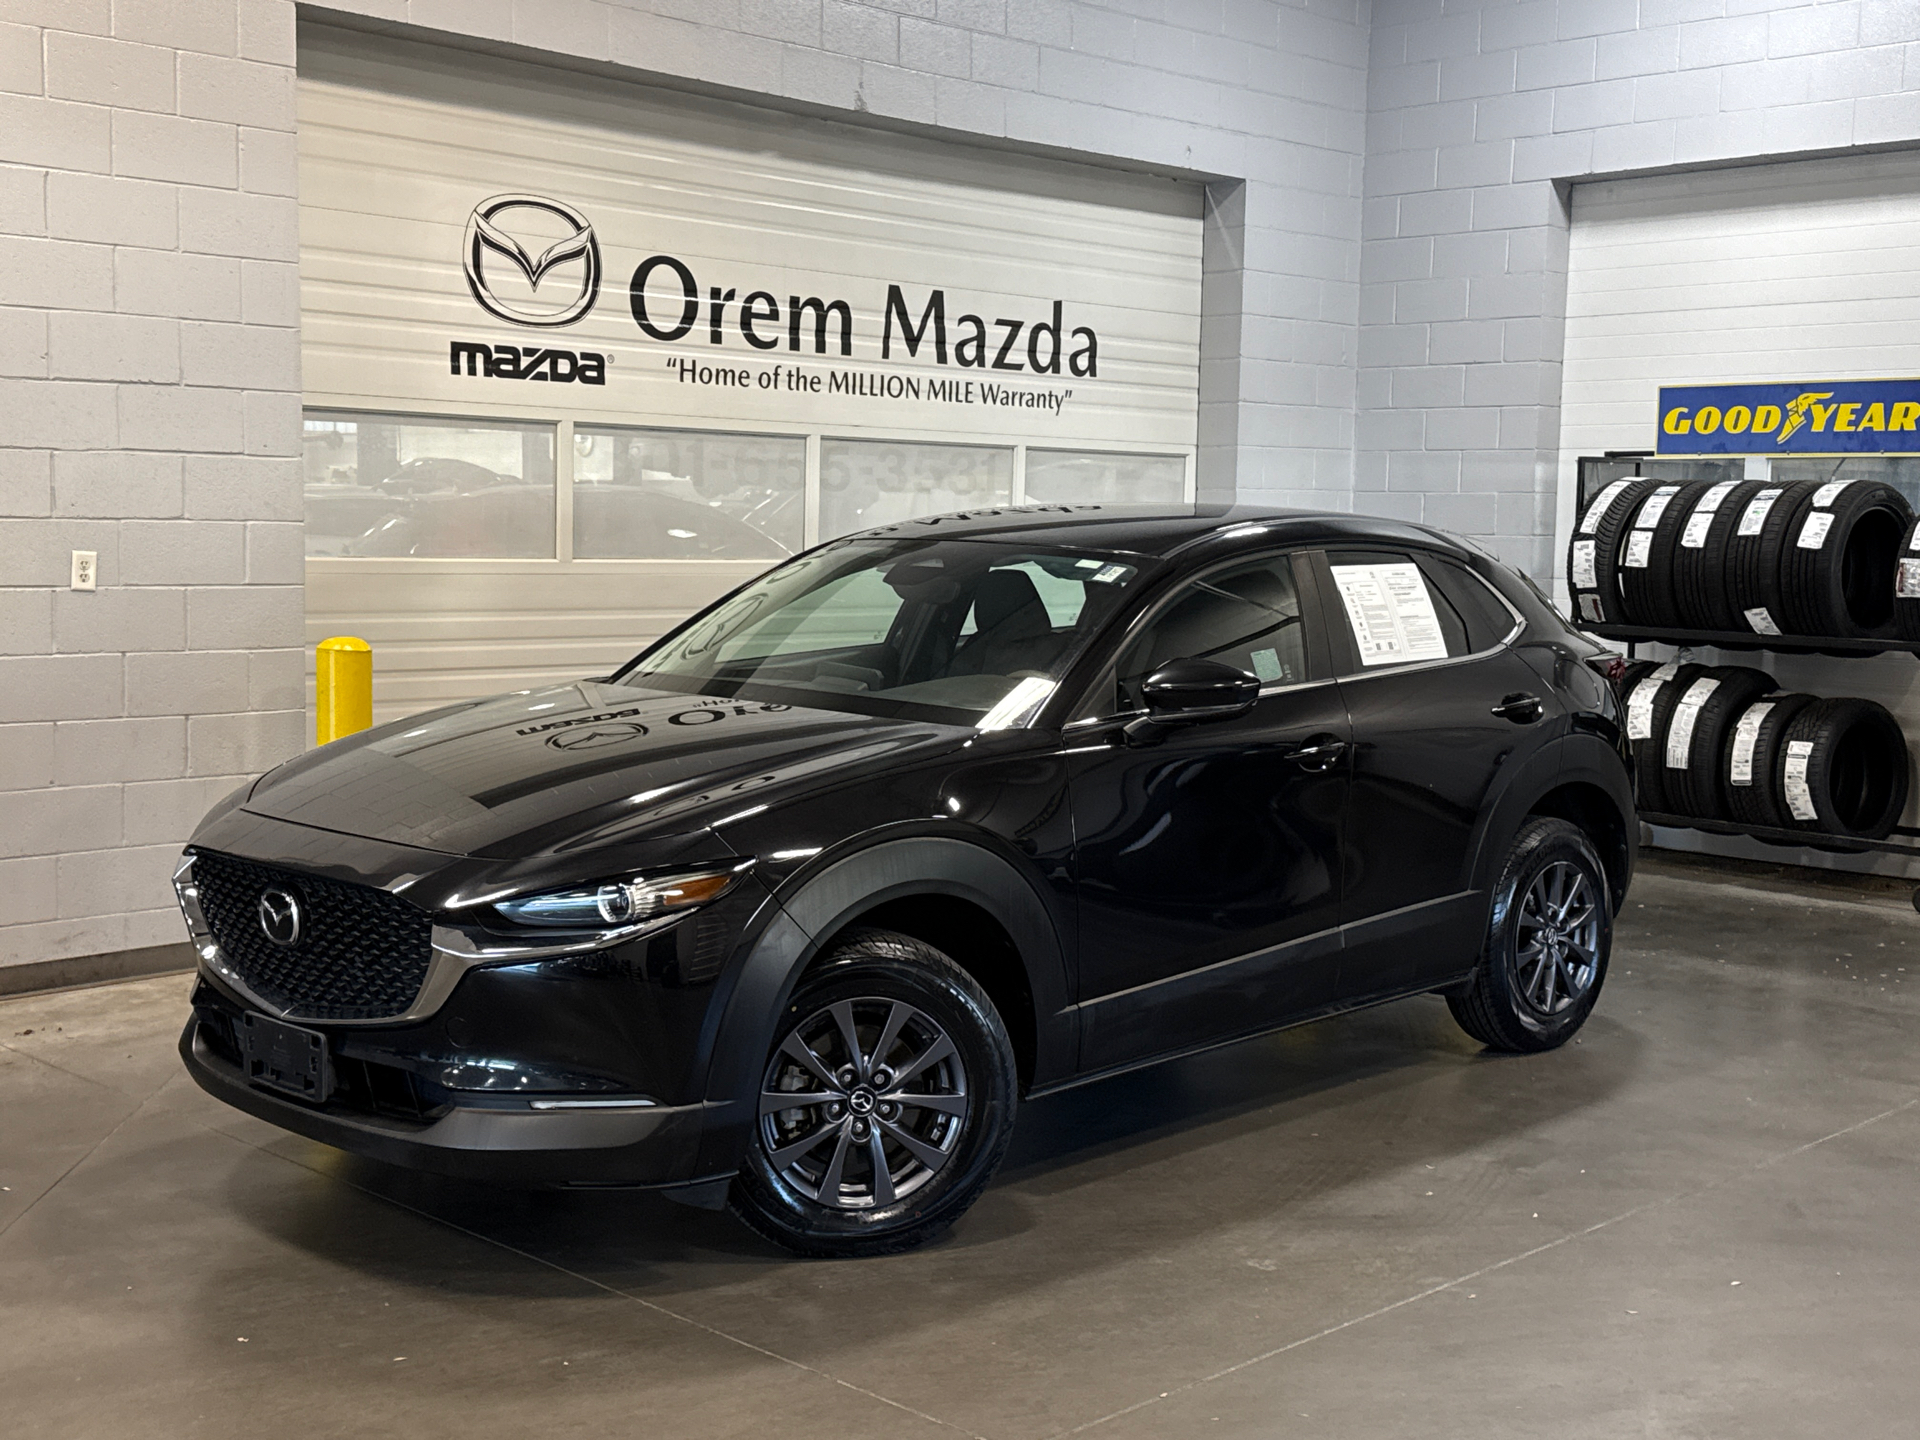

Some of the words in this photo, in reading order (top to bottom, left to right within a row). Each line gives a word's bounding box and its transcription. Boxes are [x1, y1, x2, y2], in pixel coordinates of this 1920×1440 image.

[629, 255, 853, 356] Orem
[881, 284, 1099, 378] Mazda
[758, 365, 782, 390] of
[786, 367, 822, 393] the
[828, 371, 920, 400] MILLION
[927, 378, 974, 404] MILE
